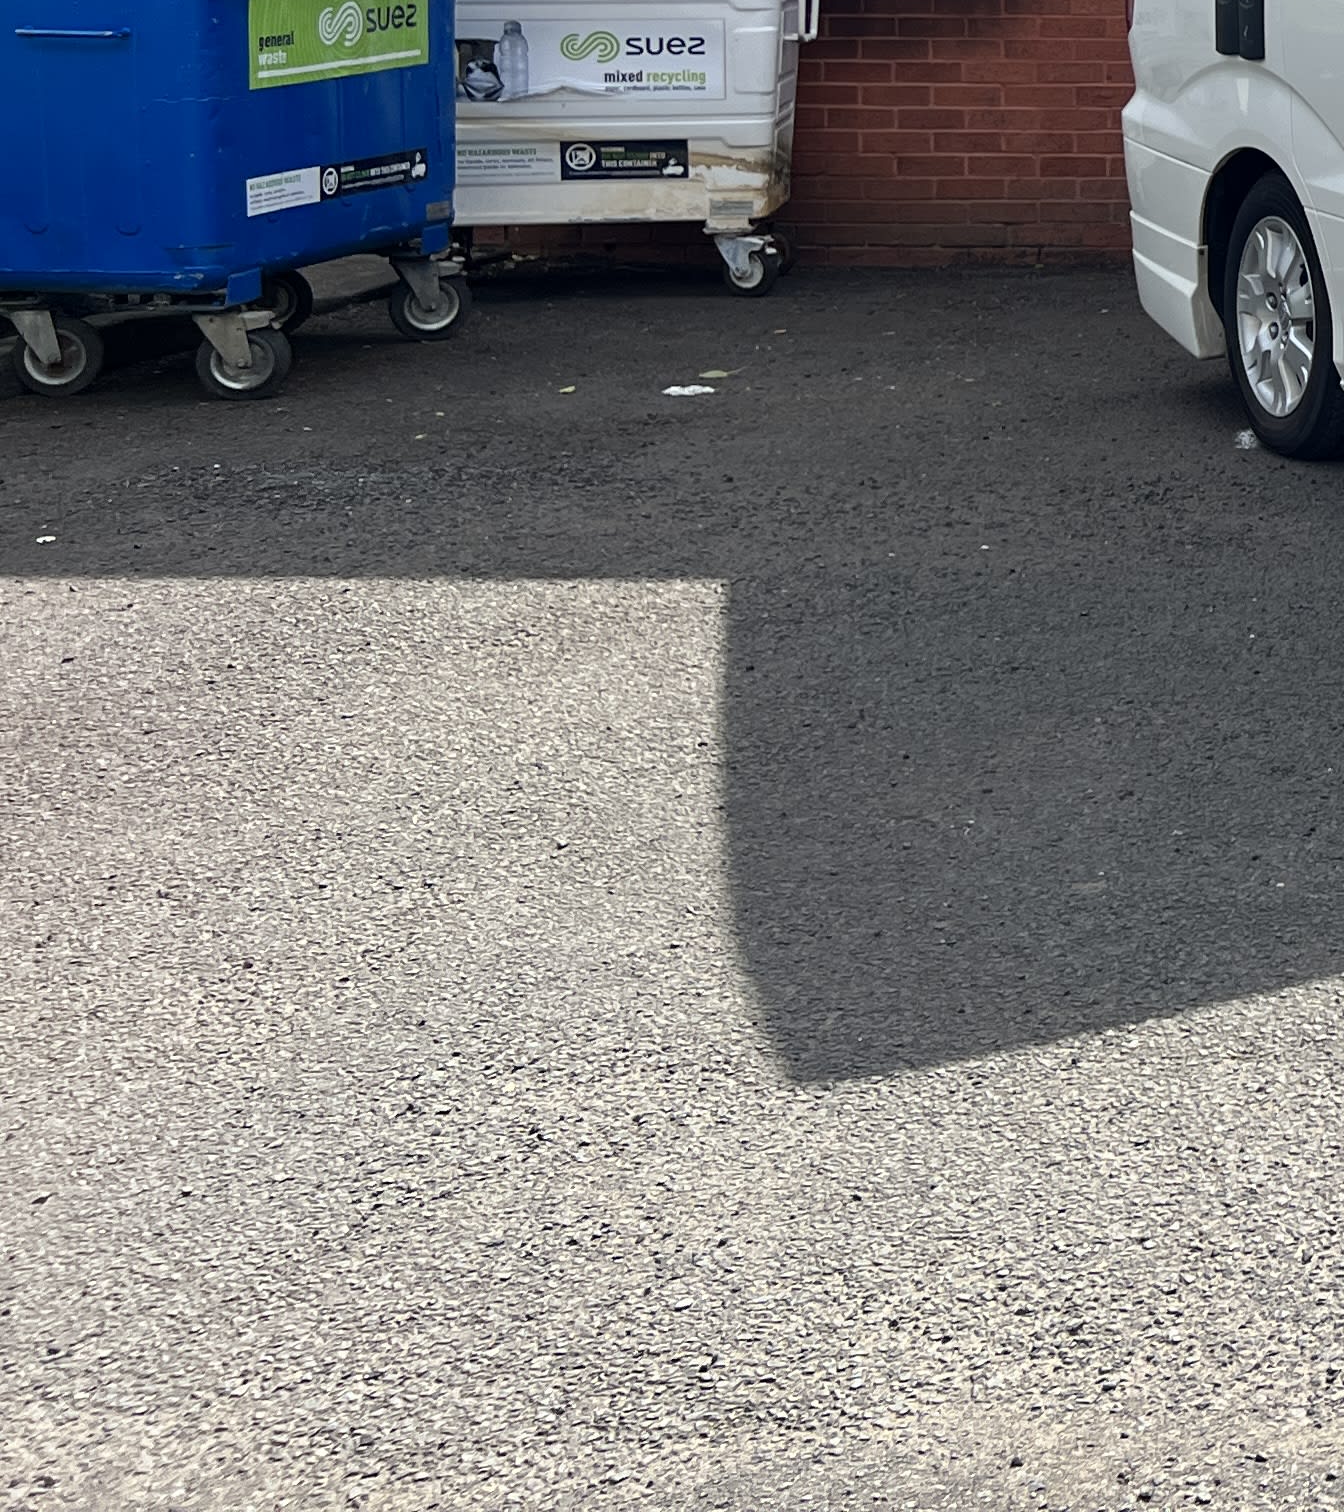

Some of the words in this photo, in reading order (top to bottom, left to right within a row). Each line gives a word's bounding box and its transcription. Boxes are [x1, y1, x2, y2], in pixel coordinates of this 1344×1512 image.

[365, 3, 418, 33] suez
[258, 30, 295, 51] general
[625, 36, 706, 56] suez
[604, 70, 643, 83] mixed
[646, 69, 706, 85] recycling
